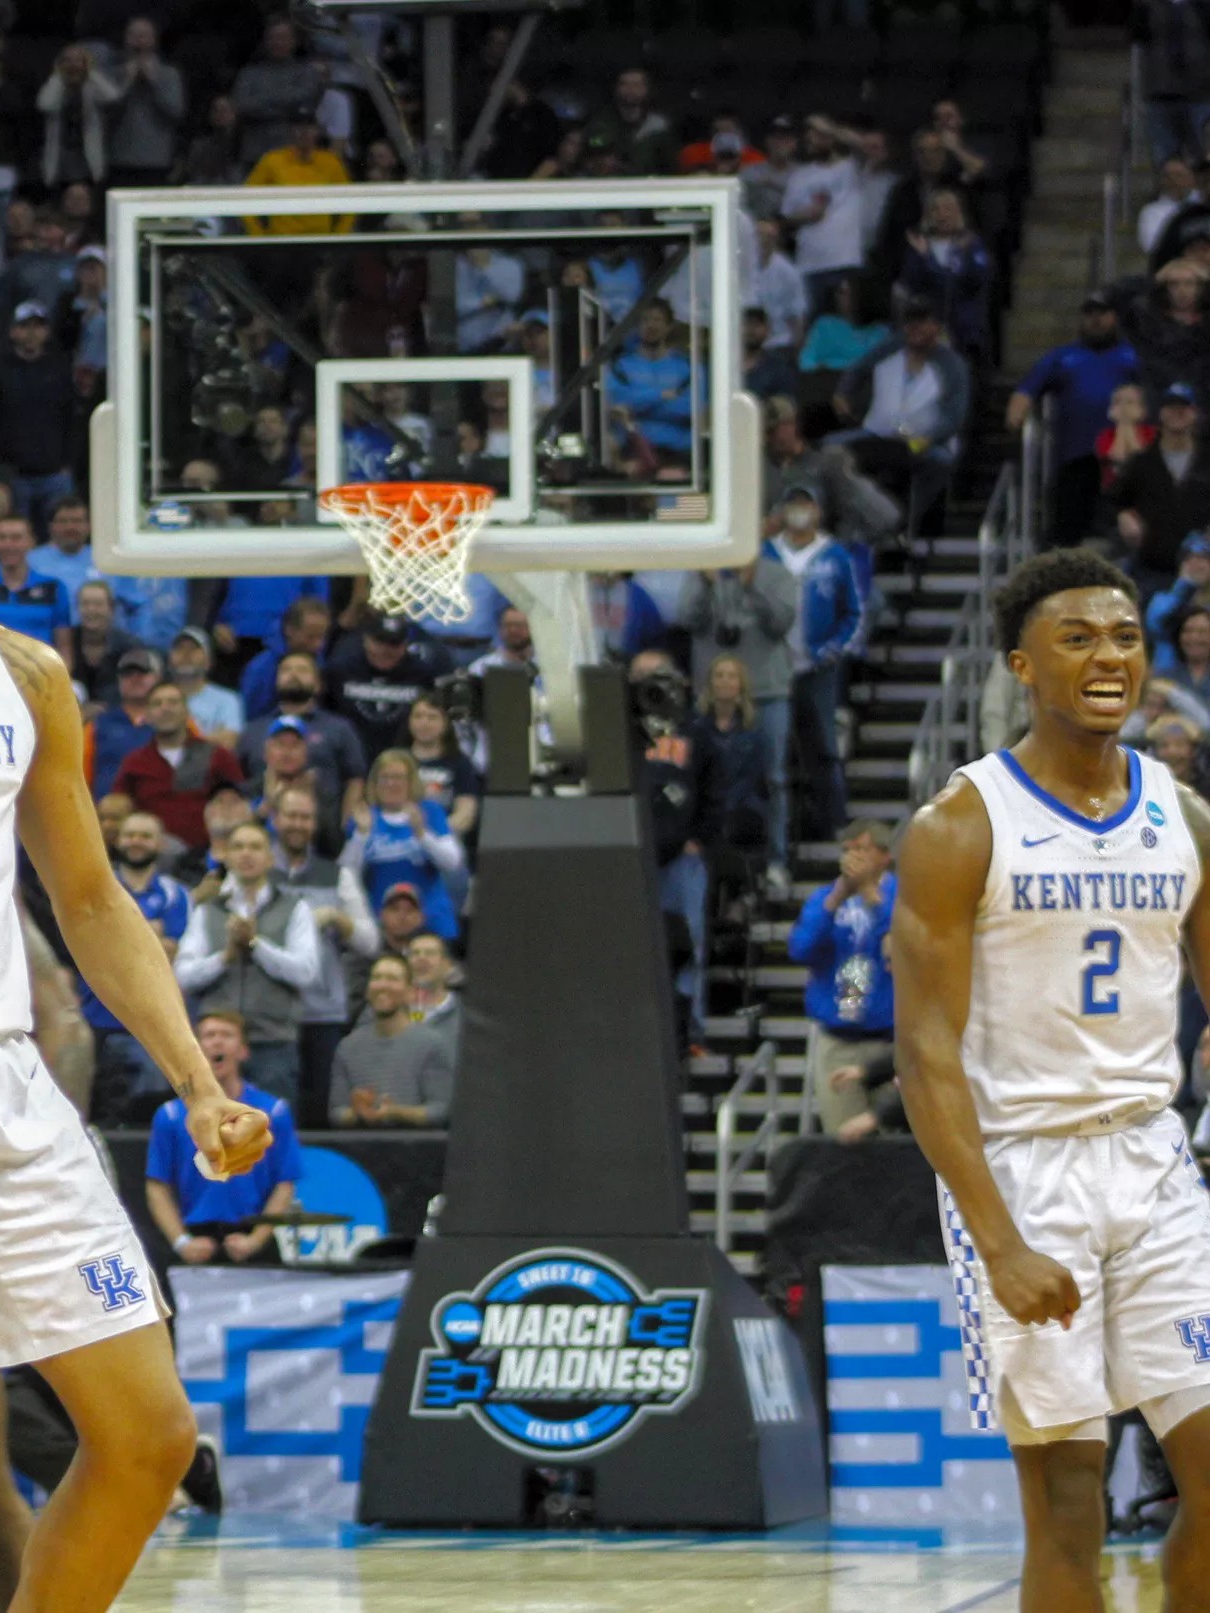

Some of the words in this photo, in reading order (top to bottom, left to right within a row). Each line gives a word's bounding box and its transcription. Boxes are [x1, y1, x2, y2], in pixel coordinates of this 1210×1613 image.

[1010, 872, 1186, 911] KENTUCKY
[1082, 929, 1121, 1015] 2
[78, 1254, 146, 1312] UK
[517, 1264, 571, 1289] SWEET
[480, 1304, 629, 1346] MARCH
[495, 1349, 691, 1390] MADNESS
[525, 1420, 570, 1441] ELITE
